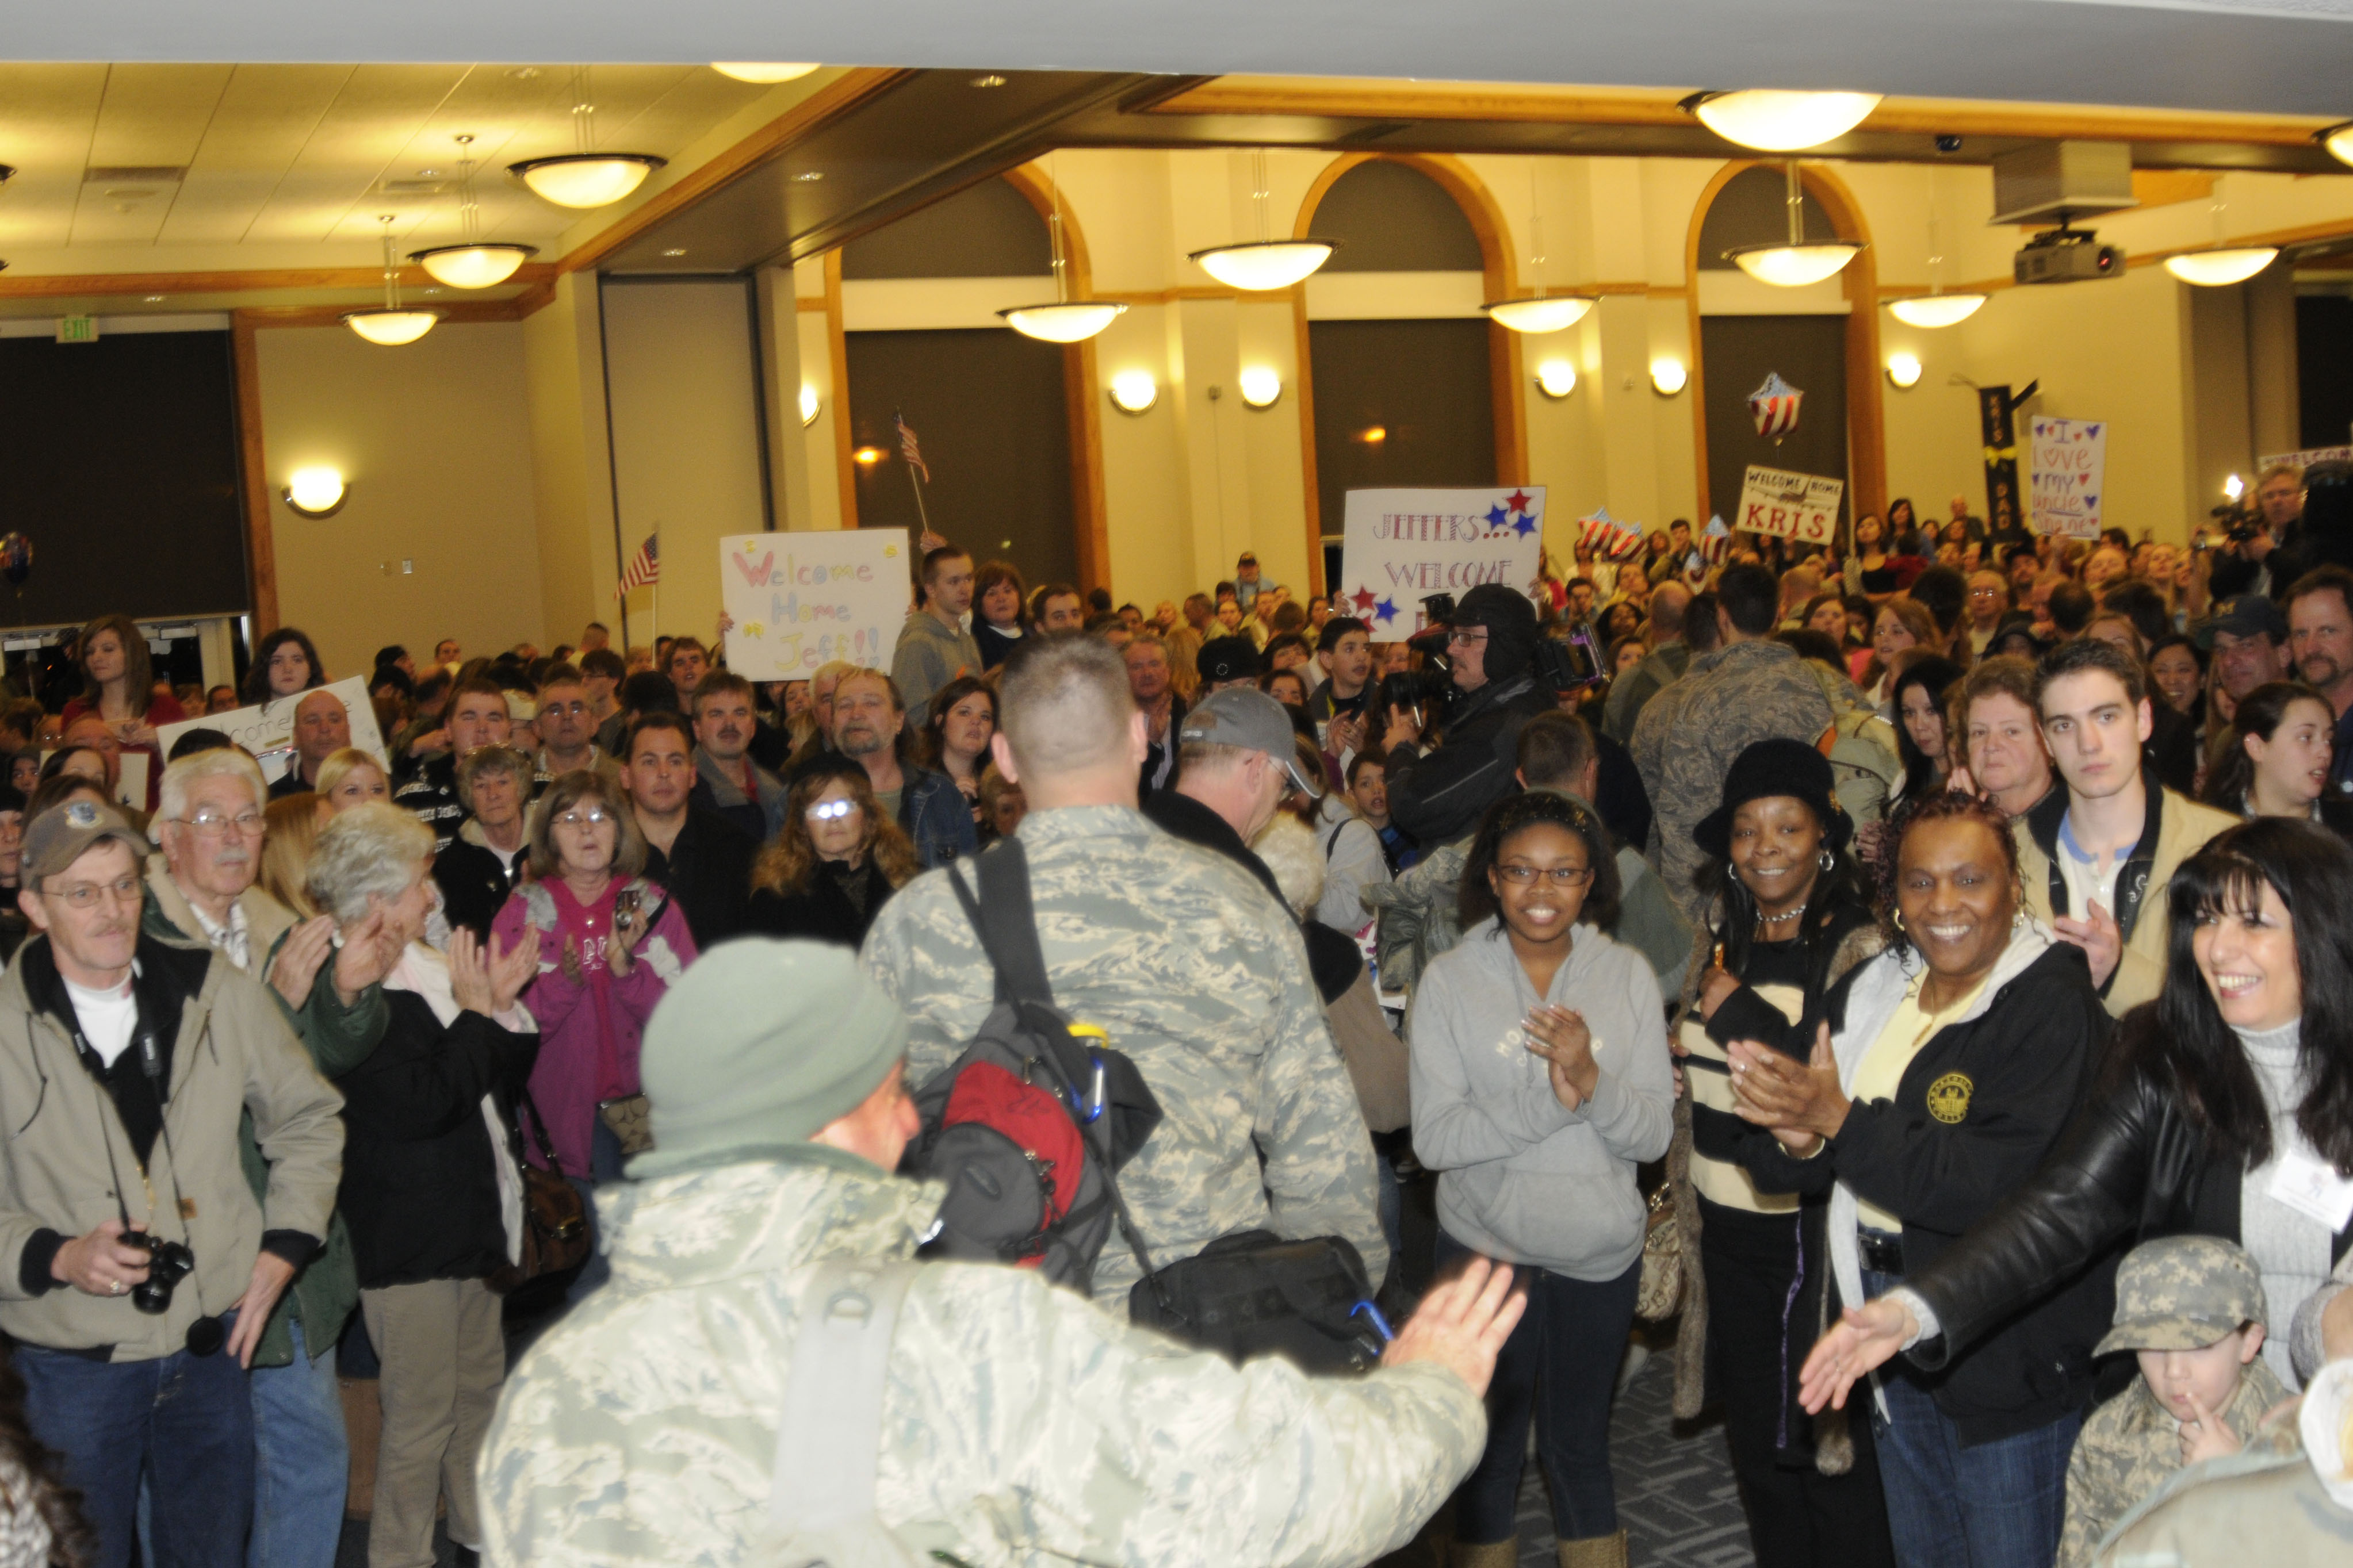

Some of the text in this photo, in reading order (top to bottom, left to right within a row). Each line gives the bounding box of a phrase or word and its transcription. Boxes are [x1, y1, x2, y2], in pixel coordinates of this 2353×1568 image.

[2054, 420, 2071, 444] I
[1747, 471, 1801, 489] WELCOME
[1745, 503, 1826, 539] KRIS
[732, 550, 875, 588] Welcome
[1384, 560, 1513, 589] WELCOME
[771, 592, 852, 626] Home
